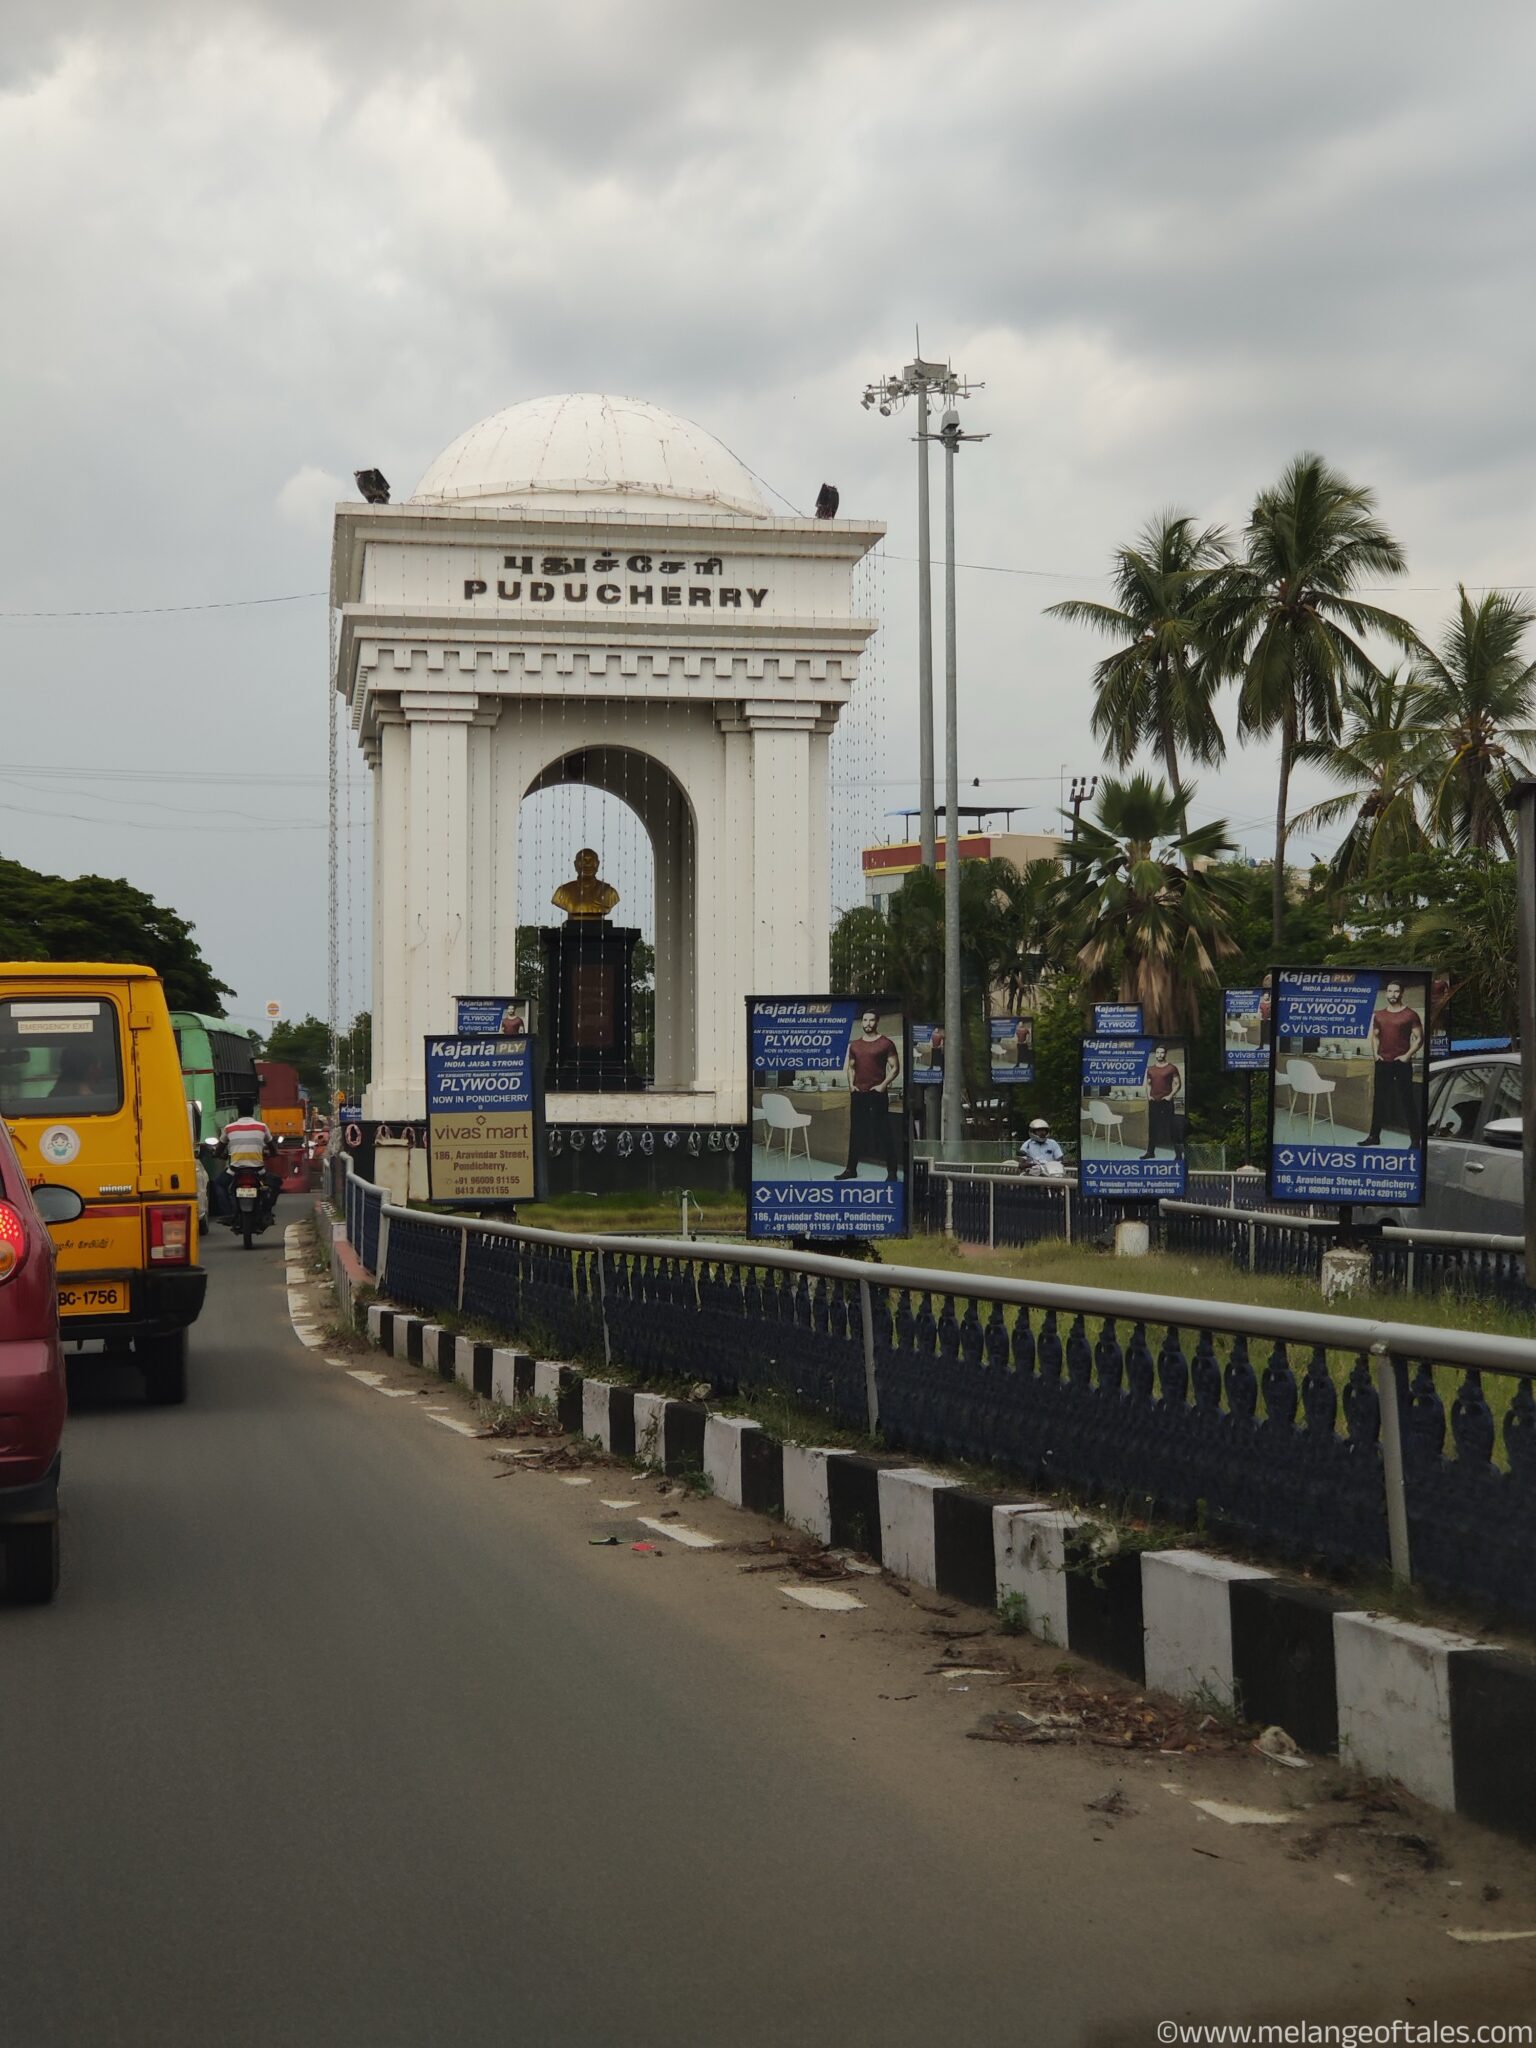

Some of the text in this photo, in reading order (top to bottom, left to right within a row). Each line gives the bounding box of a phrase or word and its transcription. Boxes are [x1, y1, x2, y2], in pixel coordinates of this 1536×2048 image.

[504, 551, 723, 579] புதுச்சேரி
[463, 580, 769, 608] PUDUCHERRY
[1279, 972, 1331, 985] Kajaria
[754, 1003, 829, 1018] Kajaria PLY
[1095, 1005, 1124, 1013] Kajaria
[1289, 1003, 1356, 1015] PLYWOOD
[20, 1023, 71, 1031] EMERGENCY
[1099, 1021, 1137, 1029] PLYWOOD
[1292, 1022, 1365, 1036] vivas mart
[764, 1035, 832, 1047] PLYWOOD
[1083, 1039, 1118, 1050] Kajaria
[431, 1041, 523, 1059] Kajaria PLY
[767, 1055, 841, 1067] vivas mart
[1089, 1062, 1136, 1071] PLYWOOD
[440, 1077, 521, 1092] PLYWOOD
[1091, 1076, 1141, 1085] vivas mart
[432, 1094, 529, 1104] NOW IN PONDICHERRY
[435, 1124, 529, 1140] vivas mart
[435, 1150, 529, 1161] 186, Aravindar Street,
[1297, 1148, 1417, 1172] vivas mart
[453, 1162, 508, 1172] Pondicherry.
[1100, 1162, 1181, 1176] vivas mart
[455, 1176, 521, 1185] +91 96009 91155
[1277, 1175, 1417, 1190] 186, Aravindar Street, Pondicherry.
[775, 1184, 894, 1204] vivas mart
[754, 1212, 895, 1223] 186, Aravindar Street, Pondicherry.
[787, 1223, 808, 1232] 96009
[809, 1223, 831, 1231] 91155
[836, 1223, 854, 1231] 0413
[855, 1223, 885, 1231] 4201155
